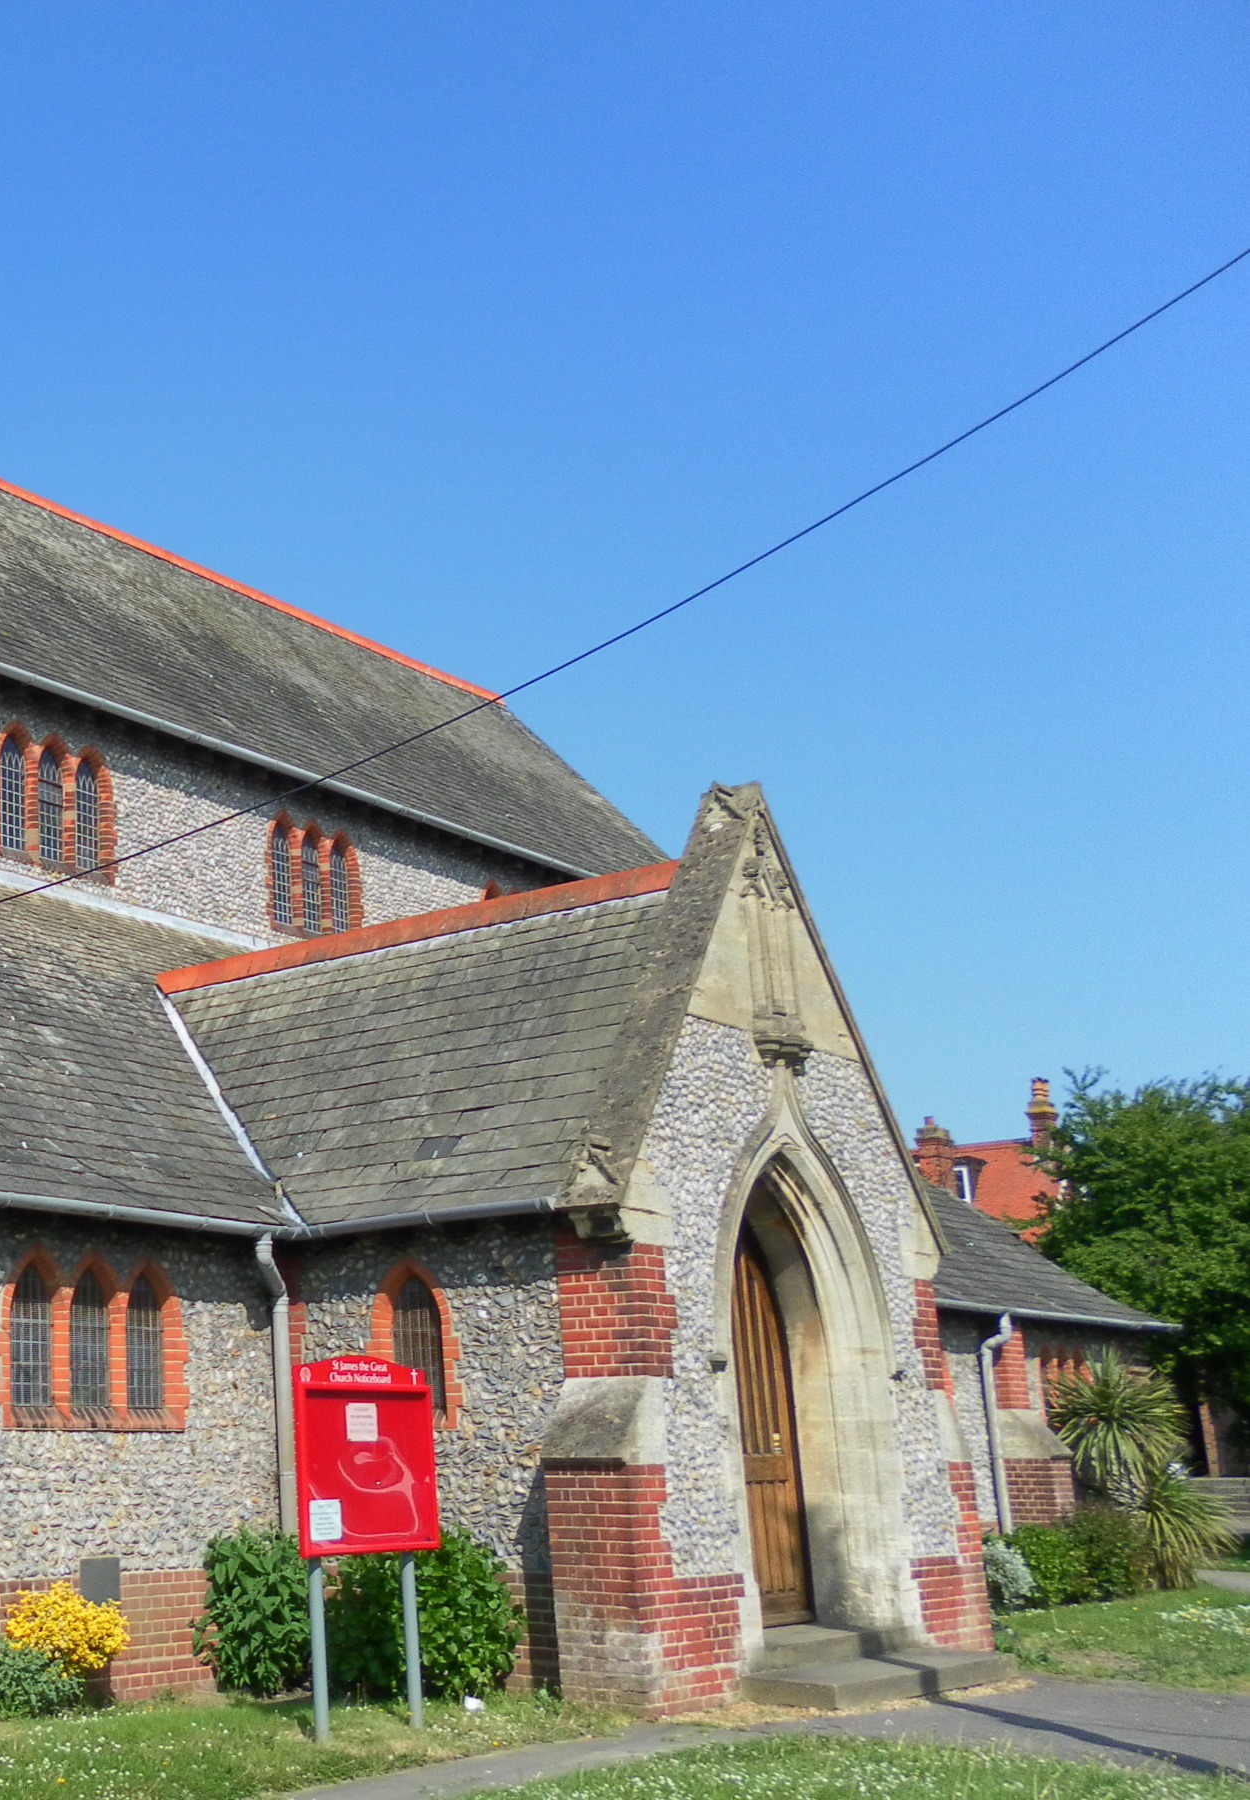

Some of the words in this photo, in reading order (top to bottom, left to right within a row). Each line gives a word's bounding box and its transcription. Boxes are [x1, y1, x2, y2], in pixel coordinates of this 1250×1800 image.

[340, 1360, 358, 1372] James
[359, 1360, 369, 1371] the
[370, 1361, 388, 1372] Great
[329, 1372, 353, 1383] Church
[353, 1373, 392, 1384] Noticeboard
